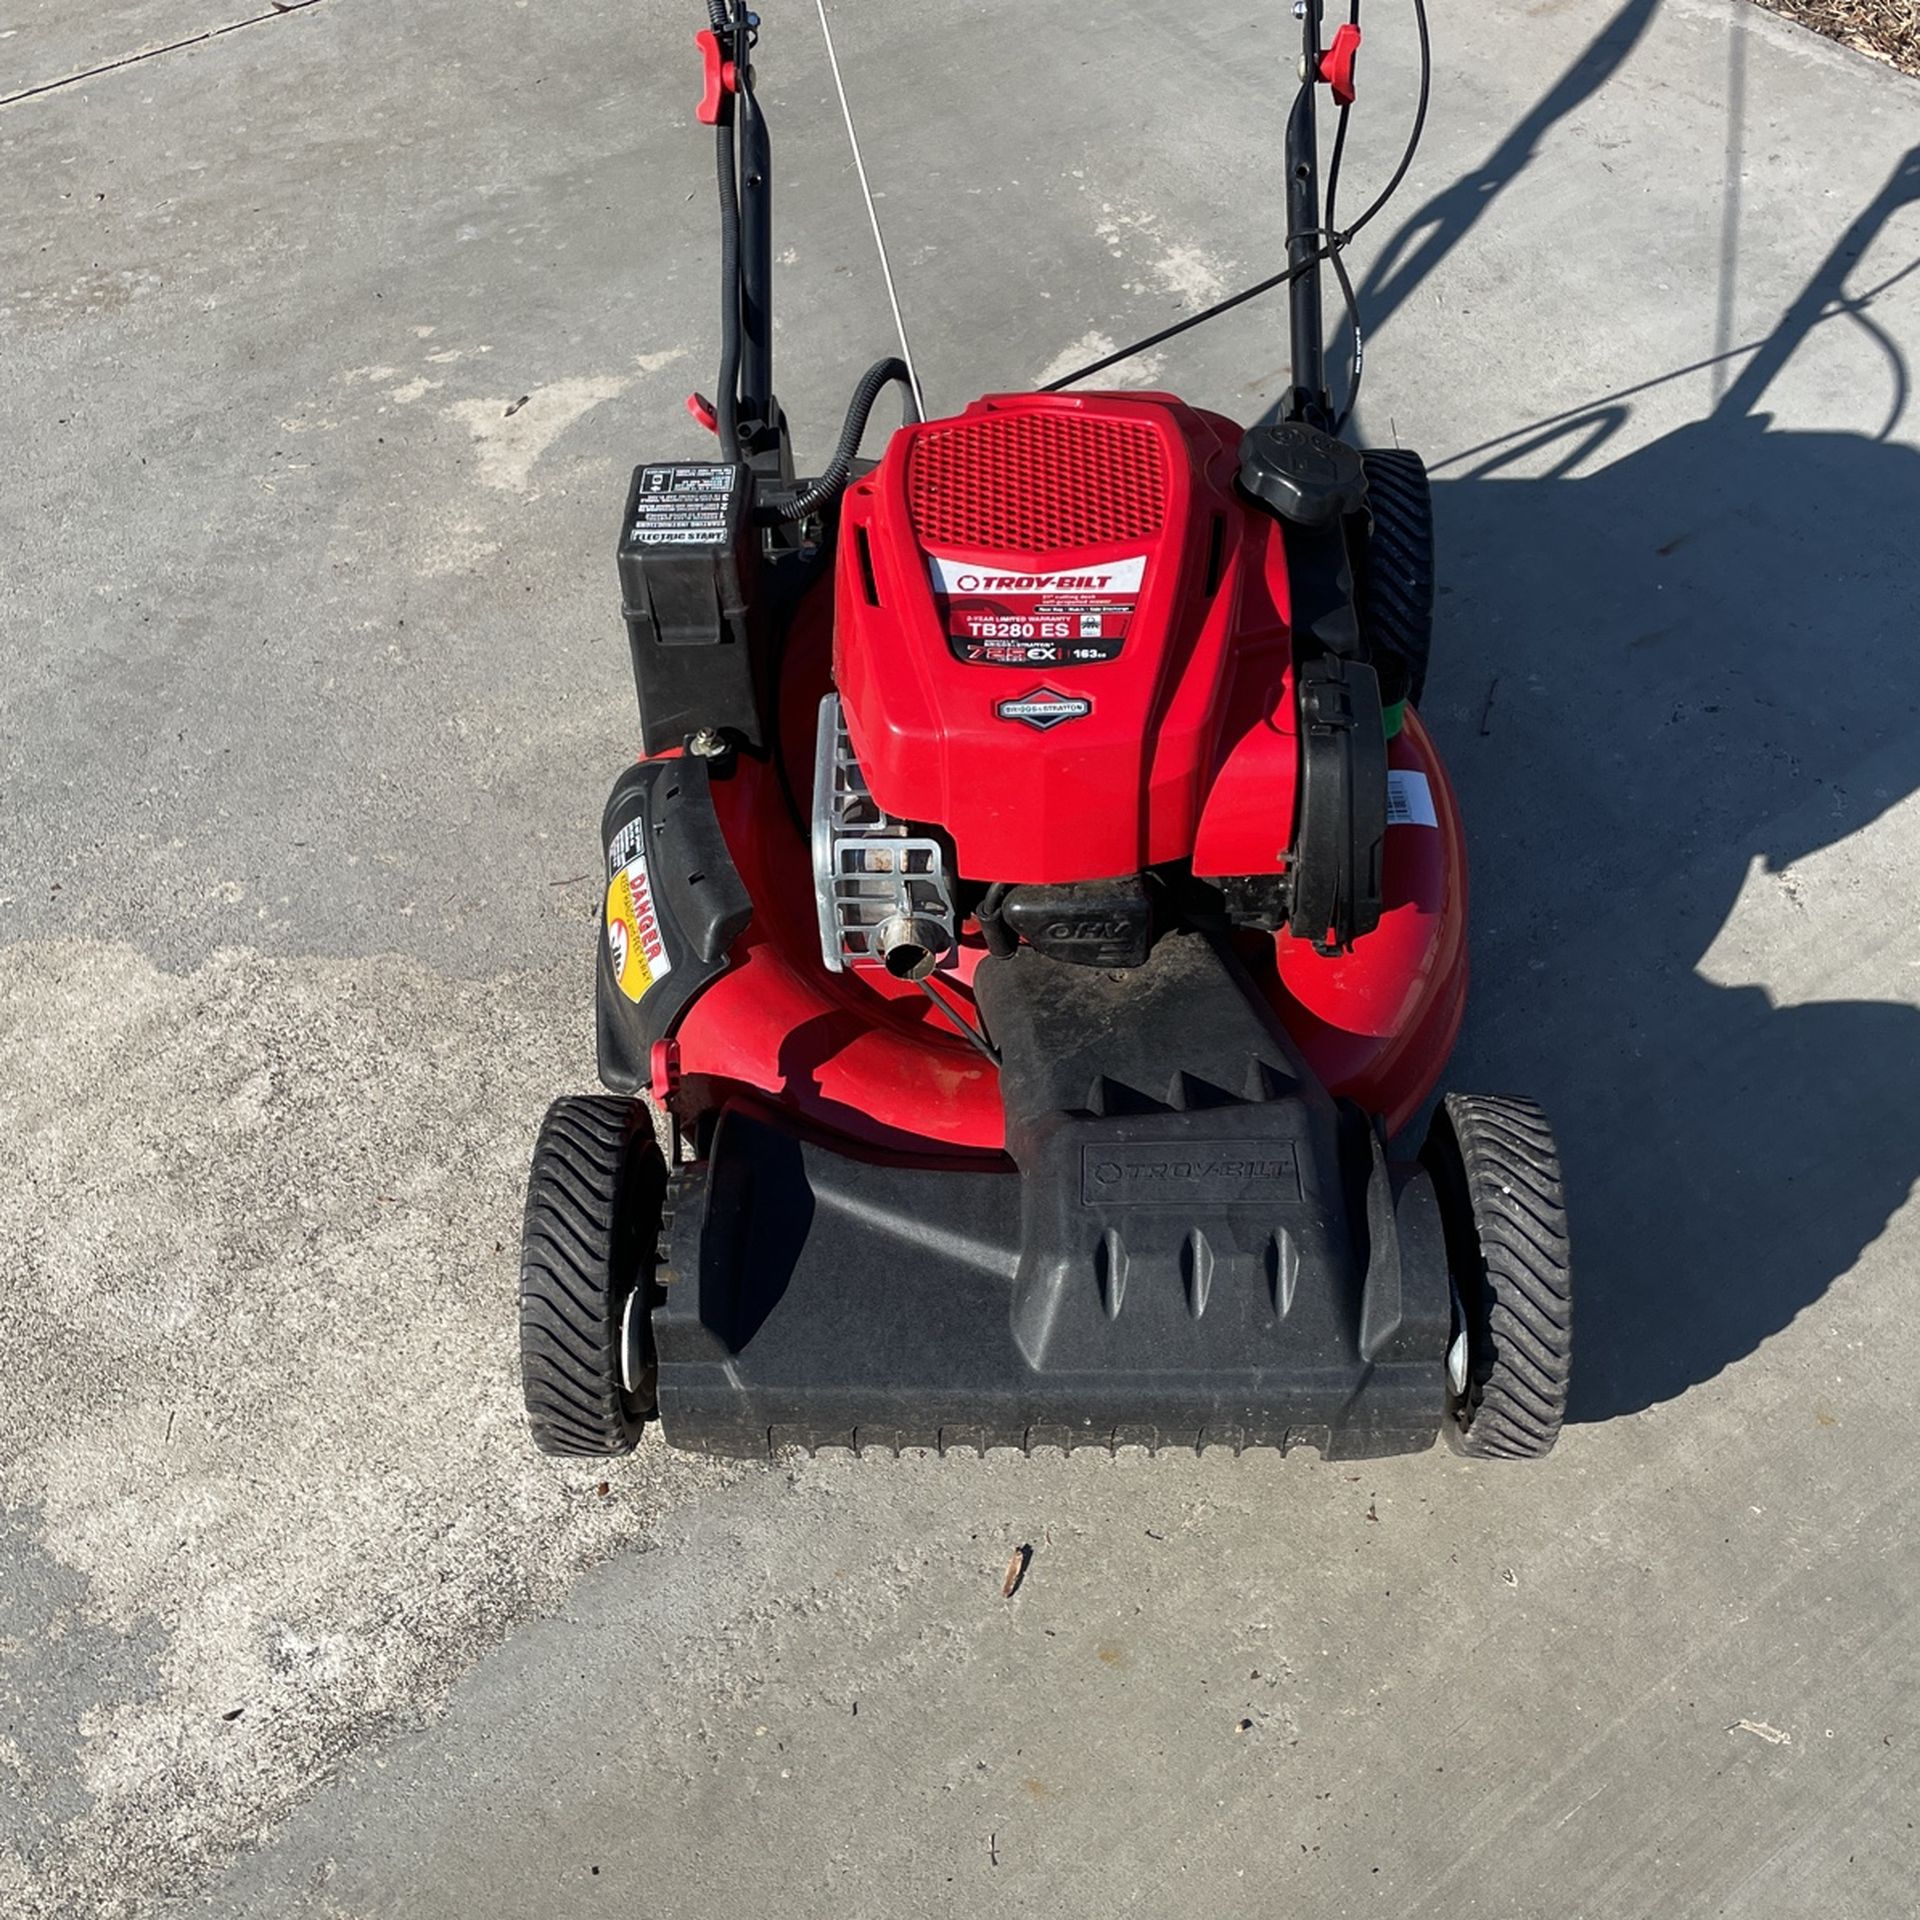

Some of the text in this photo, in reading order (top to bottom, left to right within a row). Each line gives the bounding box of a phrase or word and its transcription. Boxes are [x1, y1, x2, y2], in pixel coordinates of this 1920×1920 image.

[687, 532, 723, 540] START
[982, 576, 1112, 591] TROY-BILT
[968, 623, 1035, 638] TB280
[1041, 623, 1070, 637] ES
[629, 874, 662, 963] DANGER
[1126, 1160, 1289, 1180] TROY-BILT
